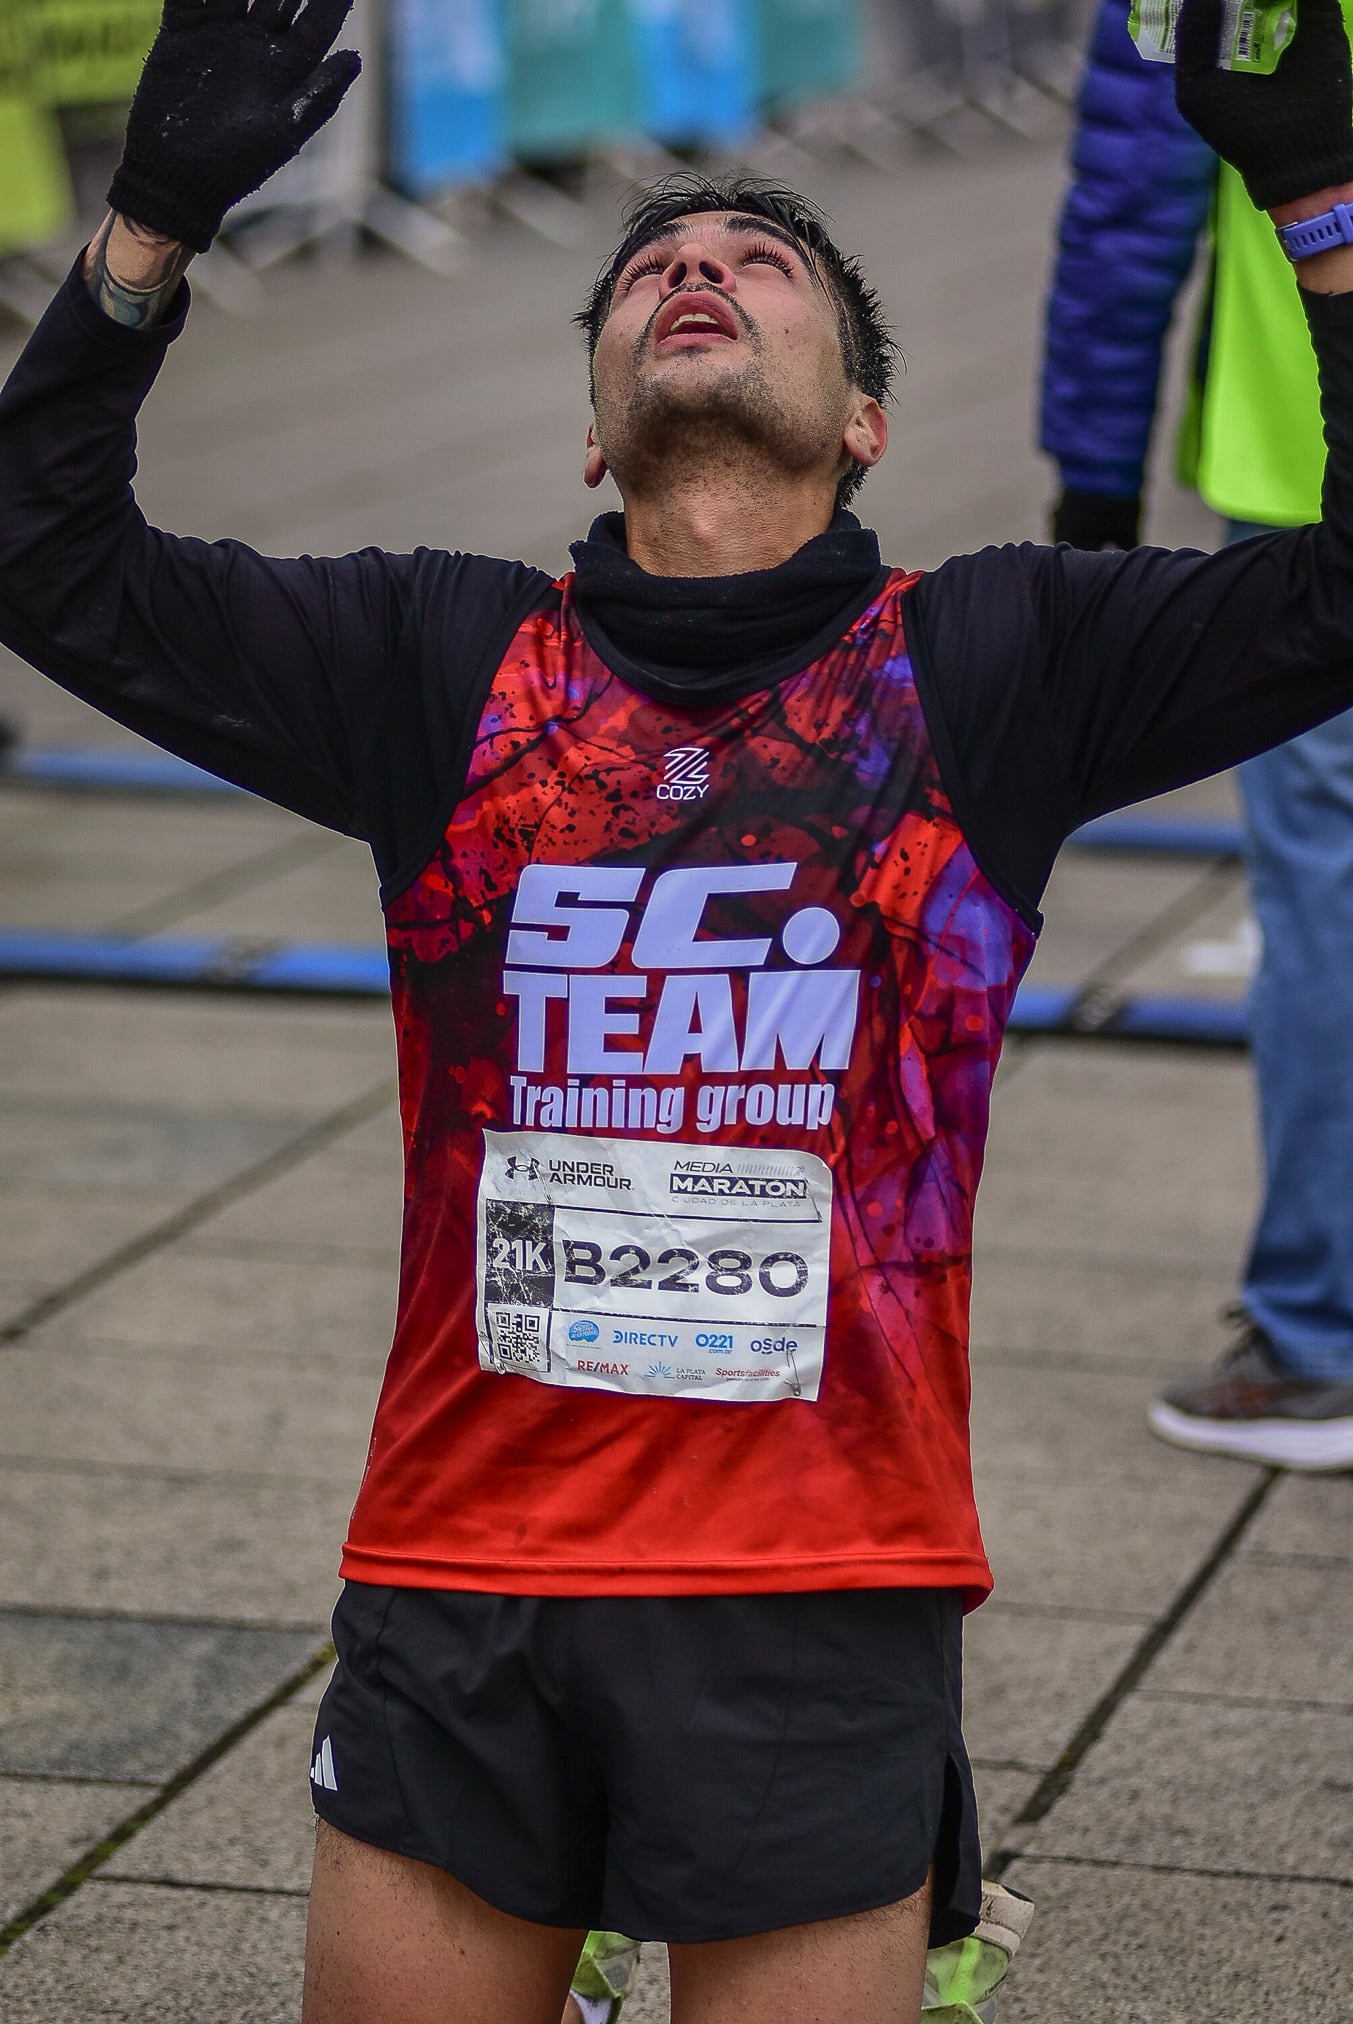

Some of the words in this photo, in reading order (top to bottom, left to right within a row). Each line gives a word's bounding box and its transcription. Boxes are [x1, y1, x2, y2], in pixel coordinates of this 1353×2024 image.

[656, 784, 710, 800] COZY
[503, 970, 861, 1074] TEAM
[510, 1076, 685, 1134] Training
[696, 1083, 835, 1133] group
[549, 1159, 614, 1176] UNDER
[674, 1160, 733, 1174] MEDIA
[549, 1173, 633, 1190] ARMOUR
[672, 1196, 716, 1205] CIUDAD
[742, 1199, 758, 1207] LA
[763, 1200, 800, 1208] PLATA
[492, 1237, 546, 1272] 21K
[561, 1239, 808, 1297] B2280
[613, 1330, 678, 1347] DIRECTV
[750, 1337, 797, 1354] osde
[577, 1360, 629, 1375] RE/MAX
[715, 1367, 780, 1378] Sportsfacilities
